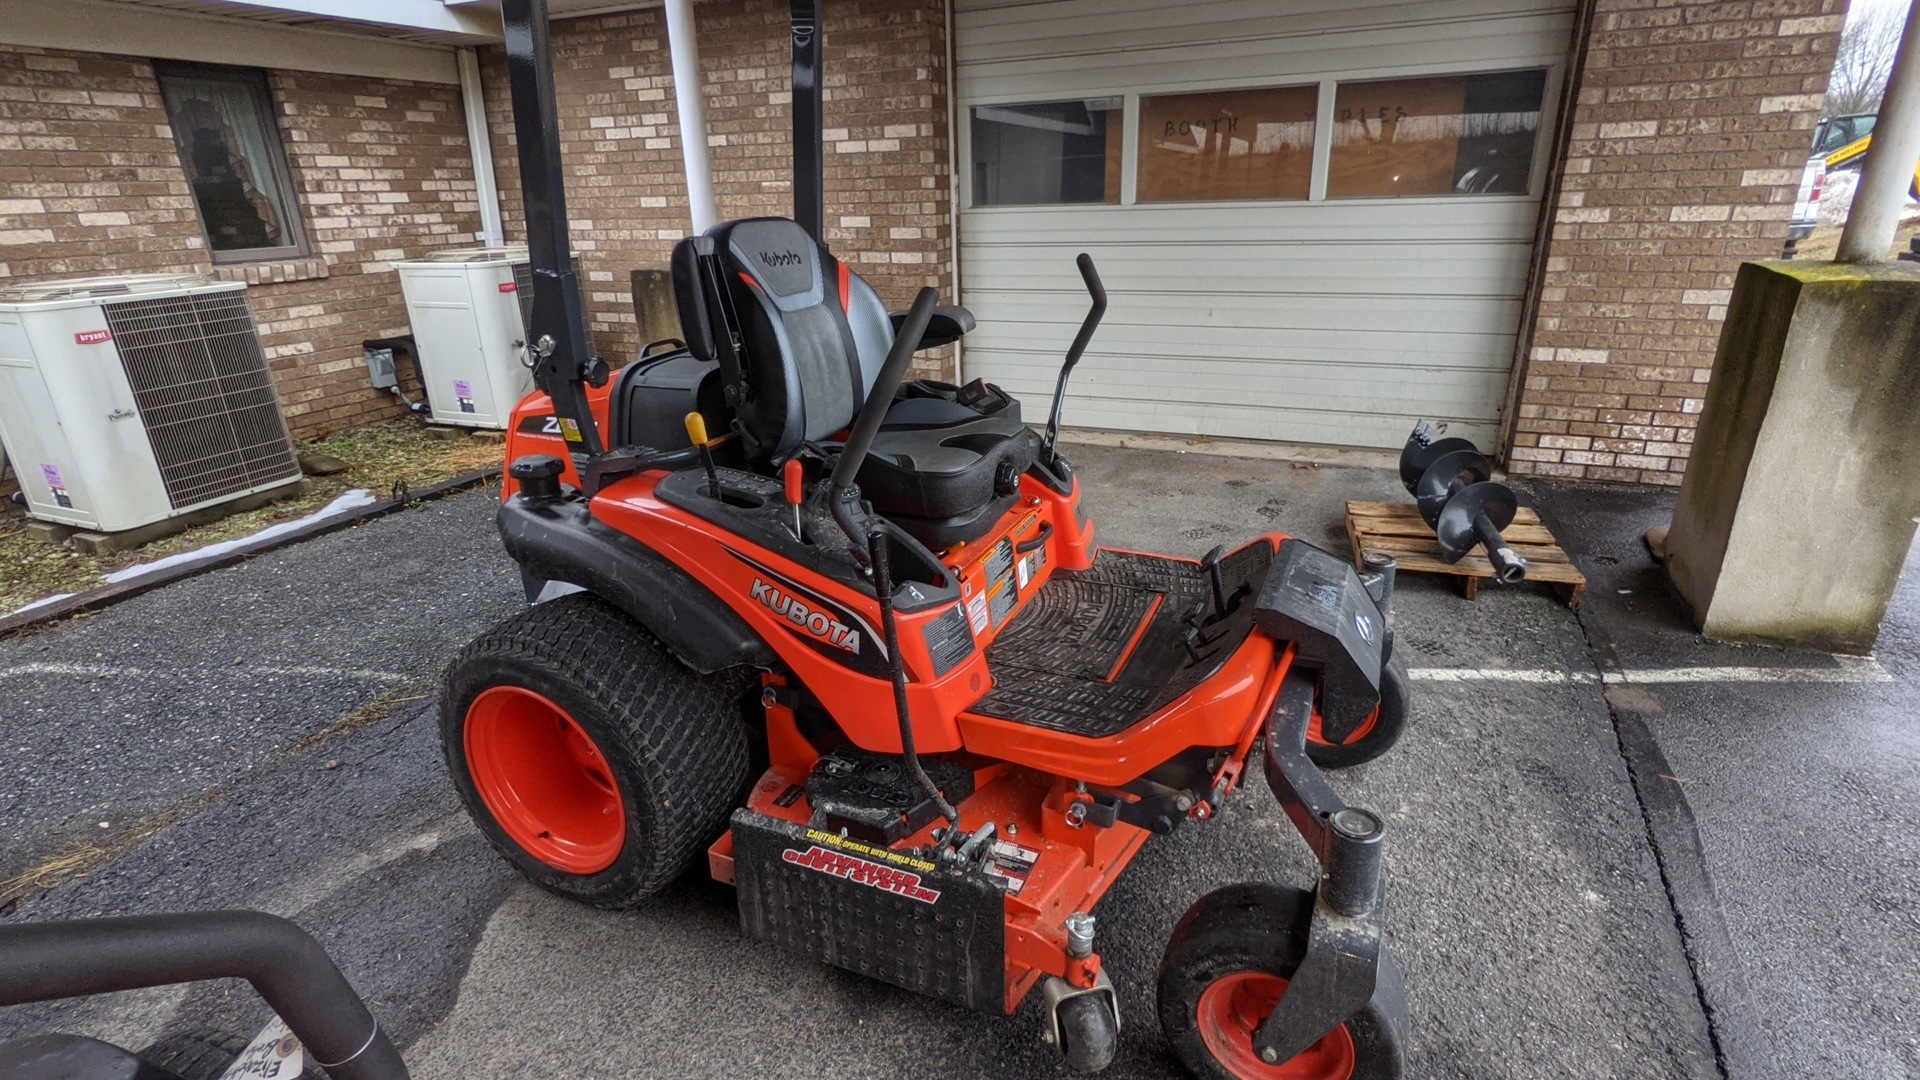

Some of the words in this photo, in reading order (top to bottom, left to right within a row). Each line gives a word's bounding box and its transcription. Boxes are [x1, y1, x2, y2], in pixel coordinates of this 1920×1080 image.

[1303, 106, 1408, 124] TBLES
[760, 250, 802, 267] Kubota
[80, 332, 106, 341] bryant
[751, 578, 860, 655] KUBOTA
[1060, 603, 1103, 648] KUBOTA
[804, 846, 921, 887] ADVANCED
[806, 829, 842, 846] CAUTION:
[842, 840, 869, 854] OPERATE
[870, 847, 886, 858] WITH
[886, 852, 909, 865] SHIELD
[910, 858, 935, 871] CLOSED
[782, 849, 849, 878] CHUTE
[849, 868, 940, 904] SYSTEM
